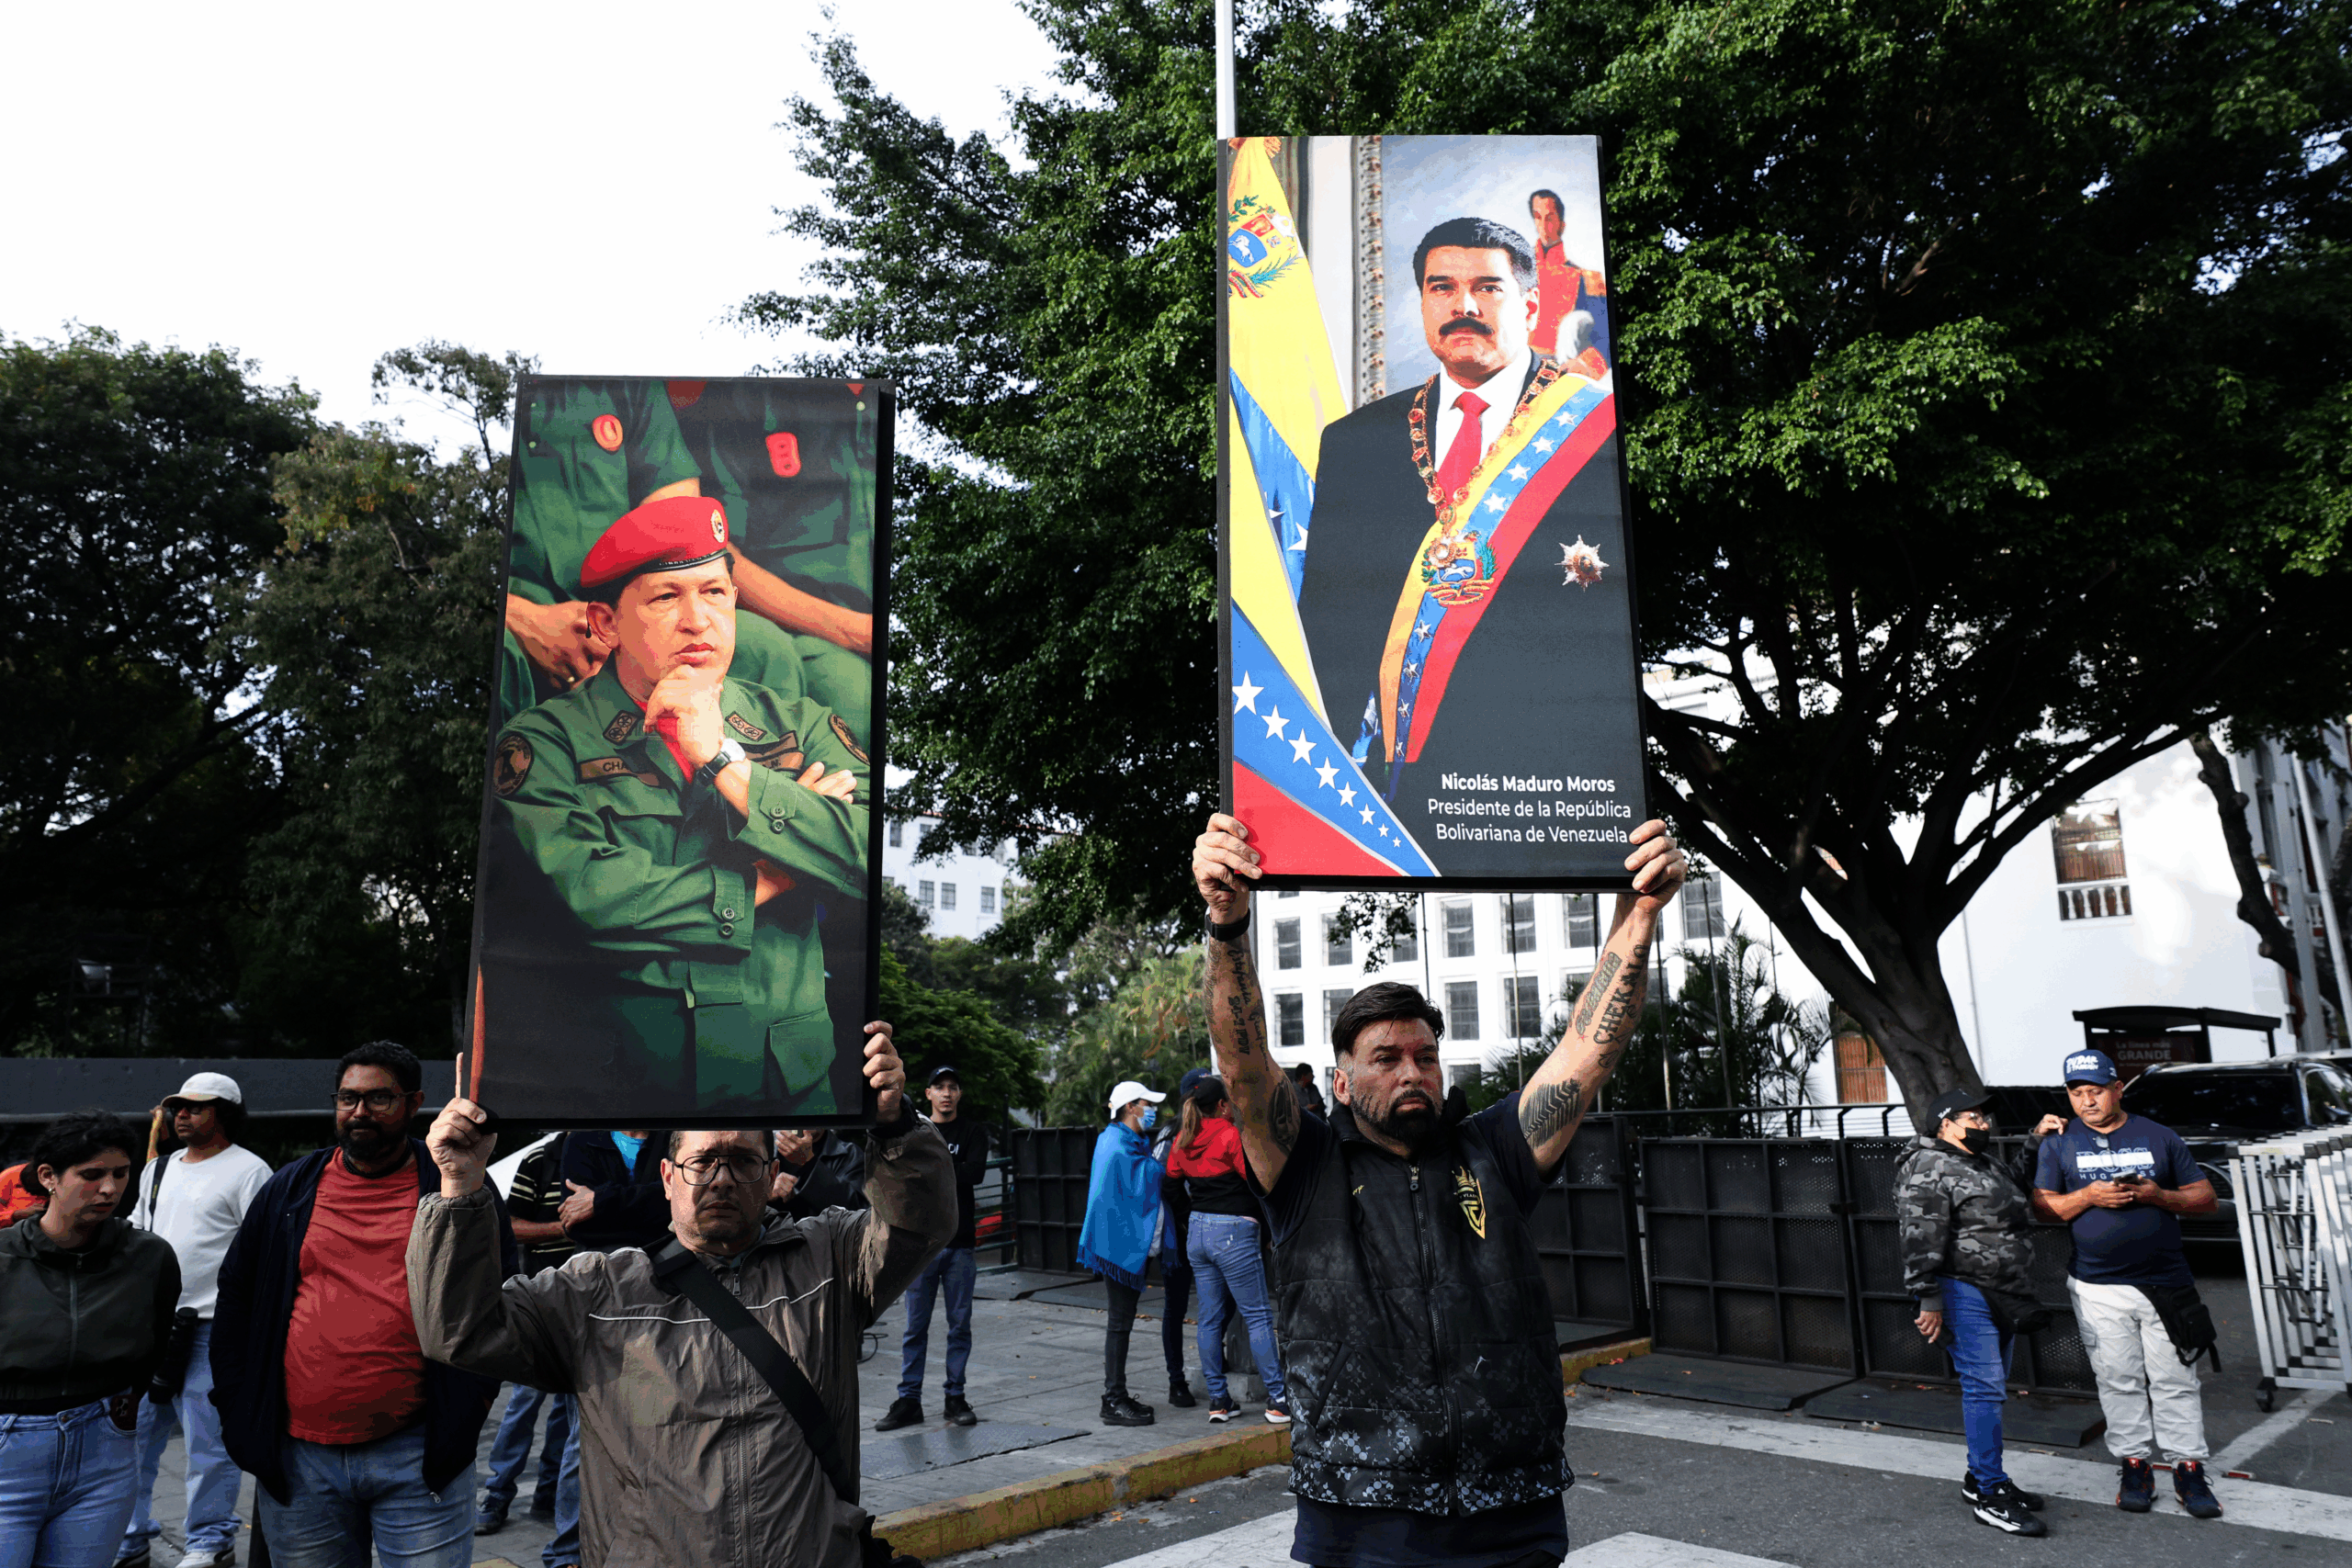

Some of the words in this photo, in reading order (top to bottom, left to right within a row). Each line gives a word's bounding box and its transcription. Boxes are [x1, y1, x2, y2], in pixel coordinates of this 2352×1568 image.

[1442, 773, 1498, 791] Nicolás
[1503, 775, 1563, 792] Maduro
[1566, 776, 1615, 792] Moros
[1429, 798, 1510, 817] Presidente
[1514, 800, 1533, 817] de
[1538, 800, 1551, 817] la
[1555, 800, 1631, 821] República
[1436, 823, 1521, 842] Bolivariana
[1525, 825, 1545, 842] de
[1548, 826, 1628, 843] Venezuela
[2117, 1050, 2172, 1060] GRANDE
